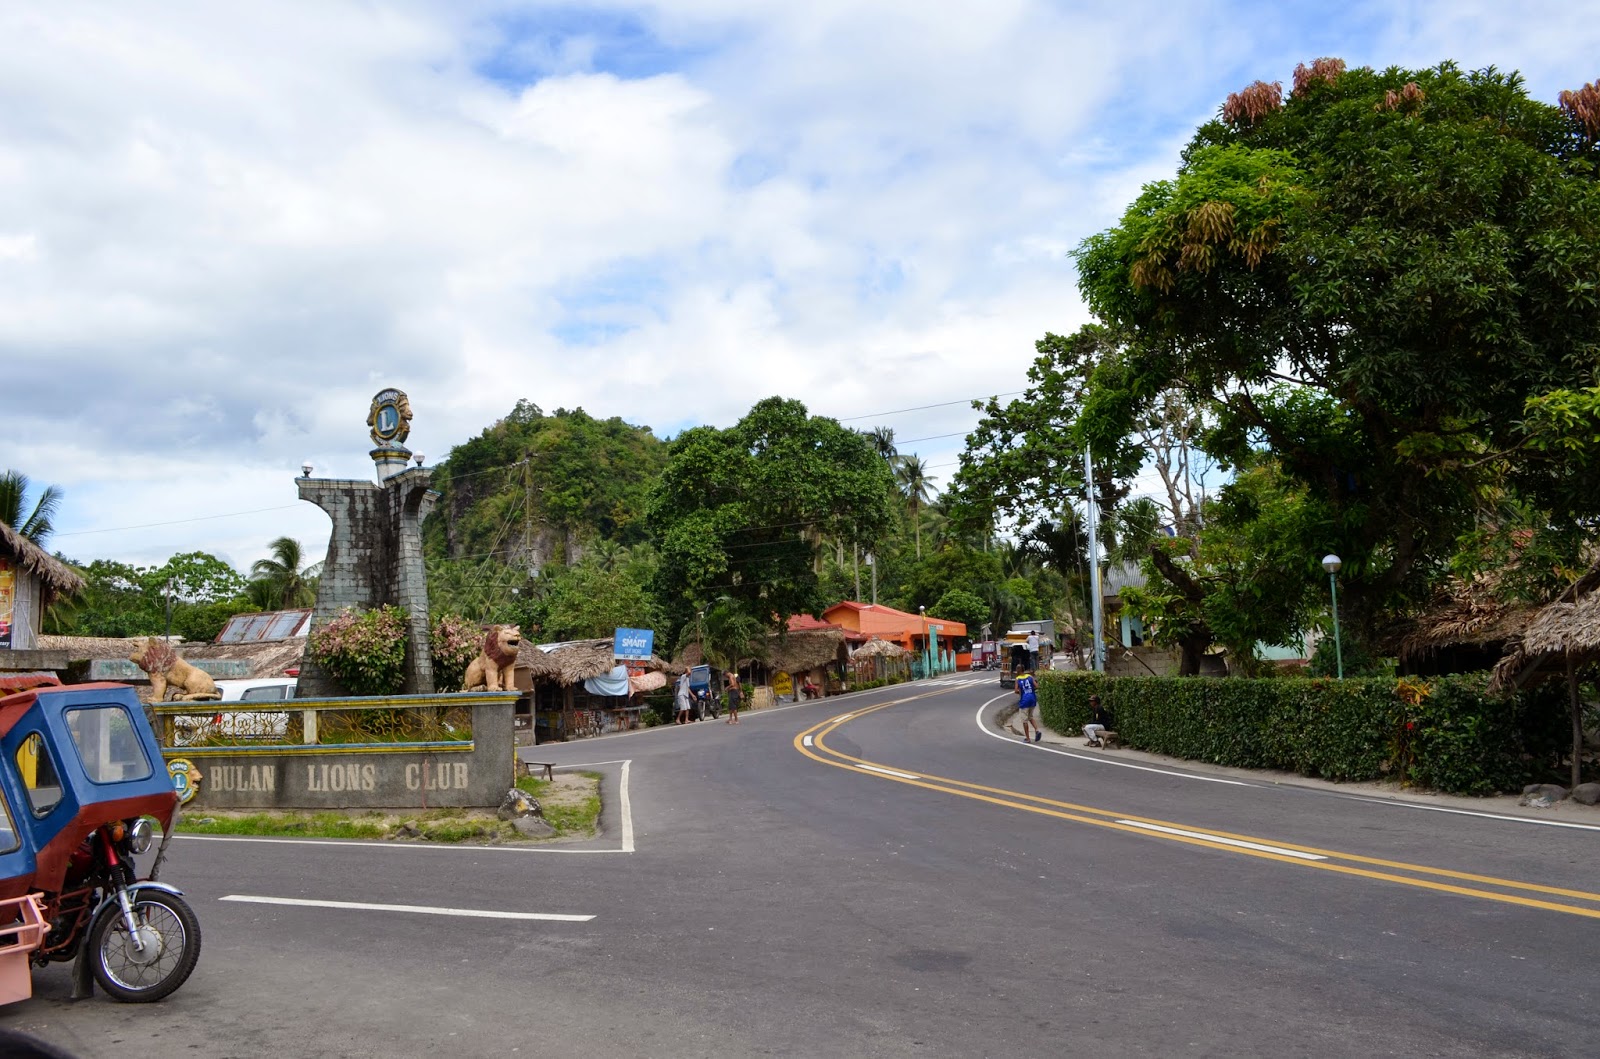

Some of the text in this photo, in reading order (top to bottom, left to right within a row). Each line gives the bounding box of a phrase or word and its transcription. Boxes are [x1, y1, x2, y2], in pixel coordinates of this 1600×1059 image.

[377, 391, 398, 402] LIONS
[380, 410, 394, 431] L
[622, 638, 647, 647] SMART
[1020, 679, 1032, 689] 14
[170, 763, 188, 771] LIONS
[175, 774, 185, 788] L
[210, 762, 469, 792] BULAN LIONS CLUB
